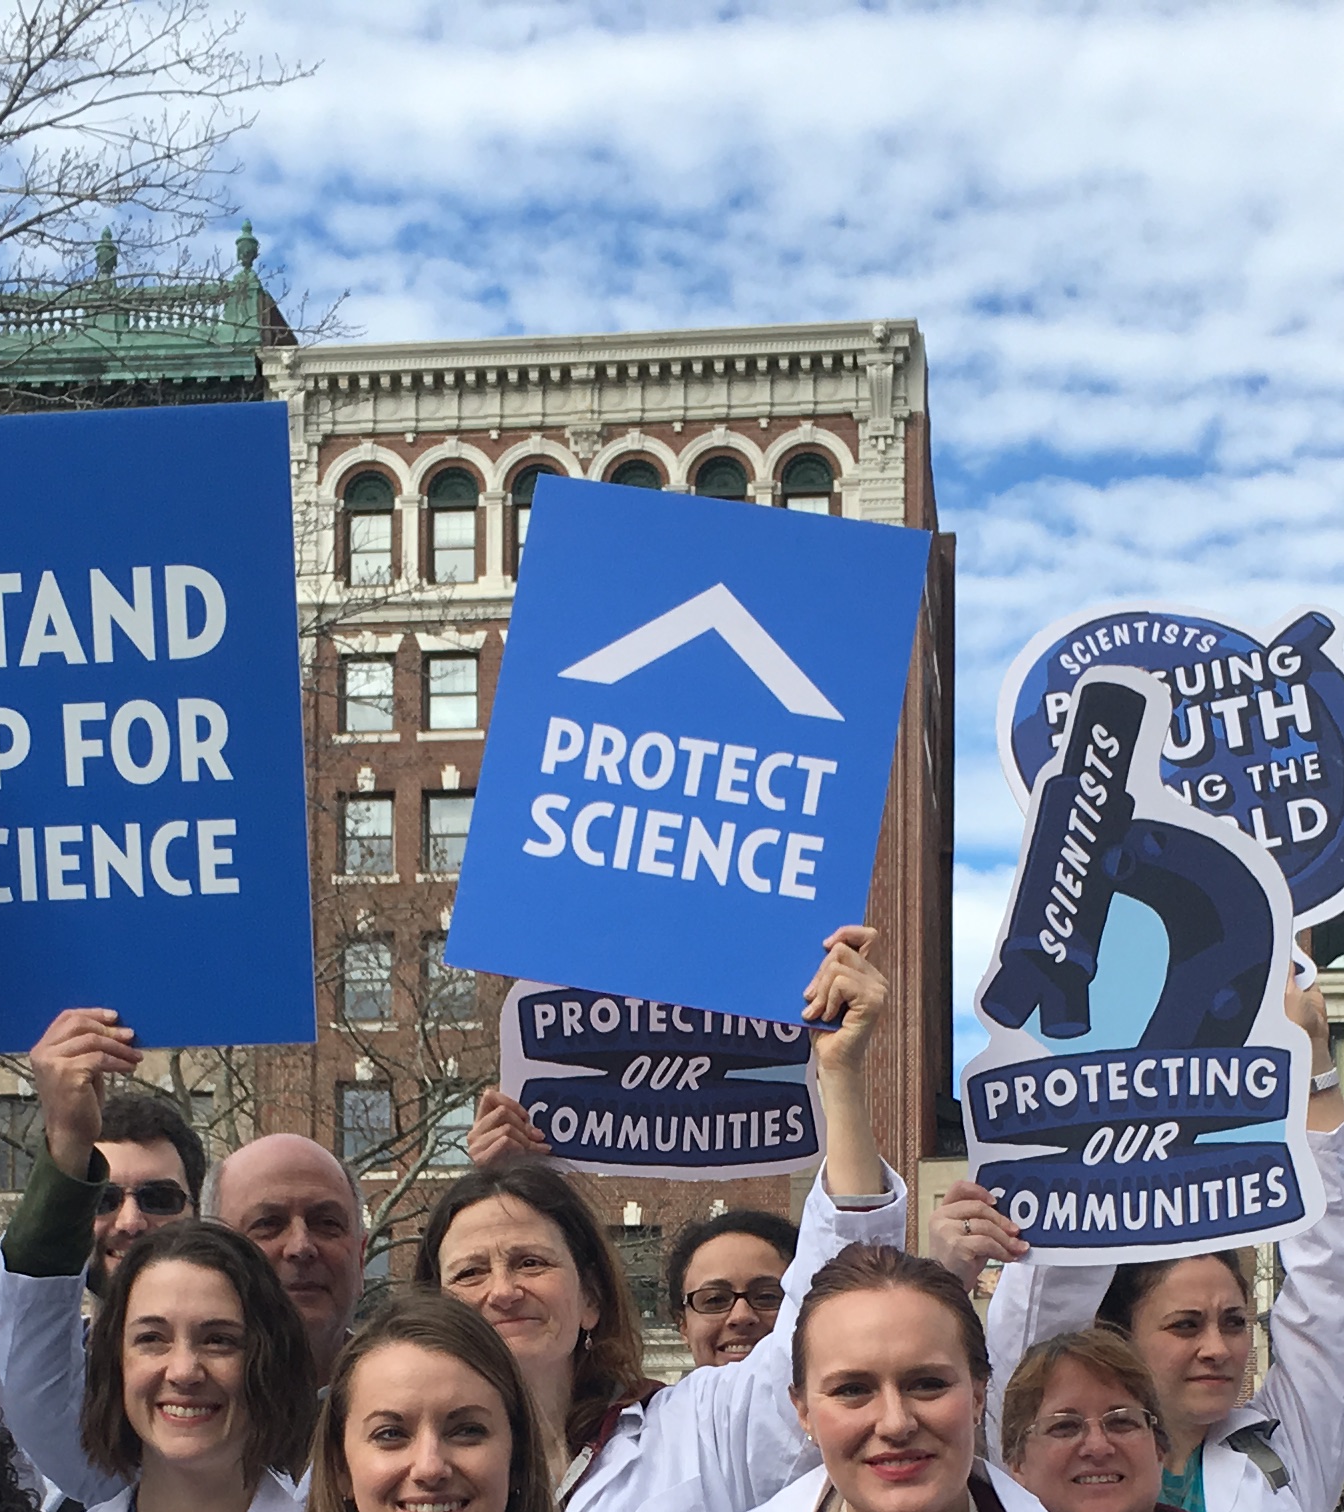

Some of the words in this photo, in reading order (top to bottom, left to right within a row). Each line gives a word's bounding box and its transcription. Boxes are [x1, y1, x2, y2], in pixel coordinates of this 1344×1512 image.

[1059, 621, 1217, 676] SCIENTISTS
[62, 698, 234, 788] FOR
[540, 716, 838, 817] PROTECT
[1246, 753, 1321, 792] THE
[522, 796, 824, 901] SCIENCE
[1037, 723, 1122, 963] SCIENTISTS
[621, 1056, 711, 1091] OUR
[984, 1057, 1279, 1121] PROTECTING
[527, 1101, 804, 1152] COMMUNITIES
[1082, 1121, 1178, 1167] OUR
